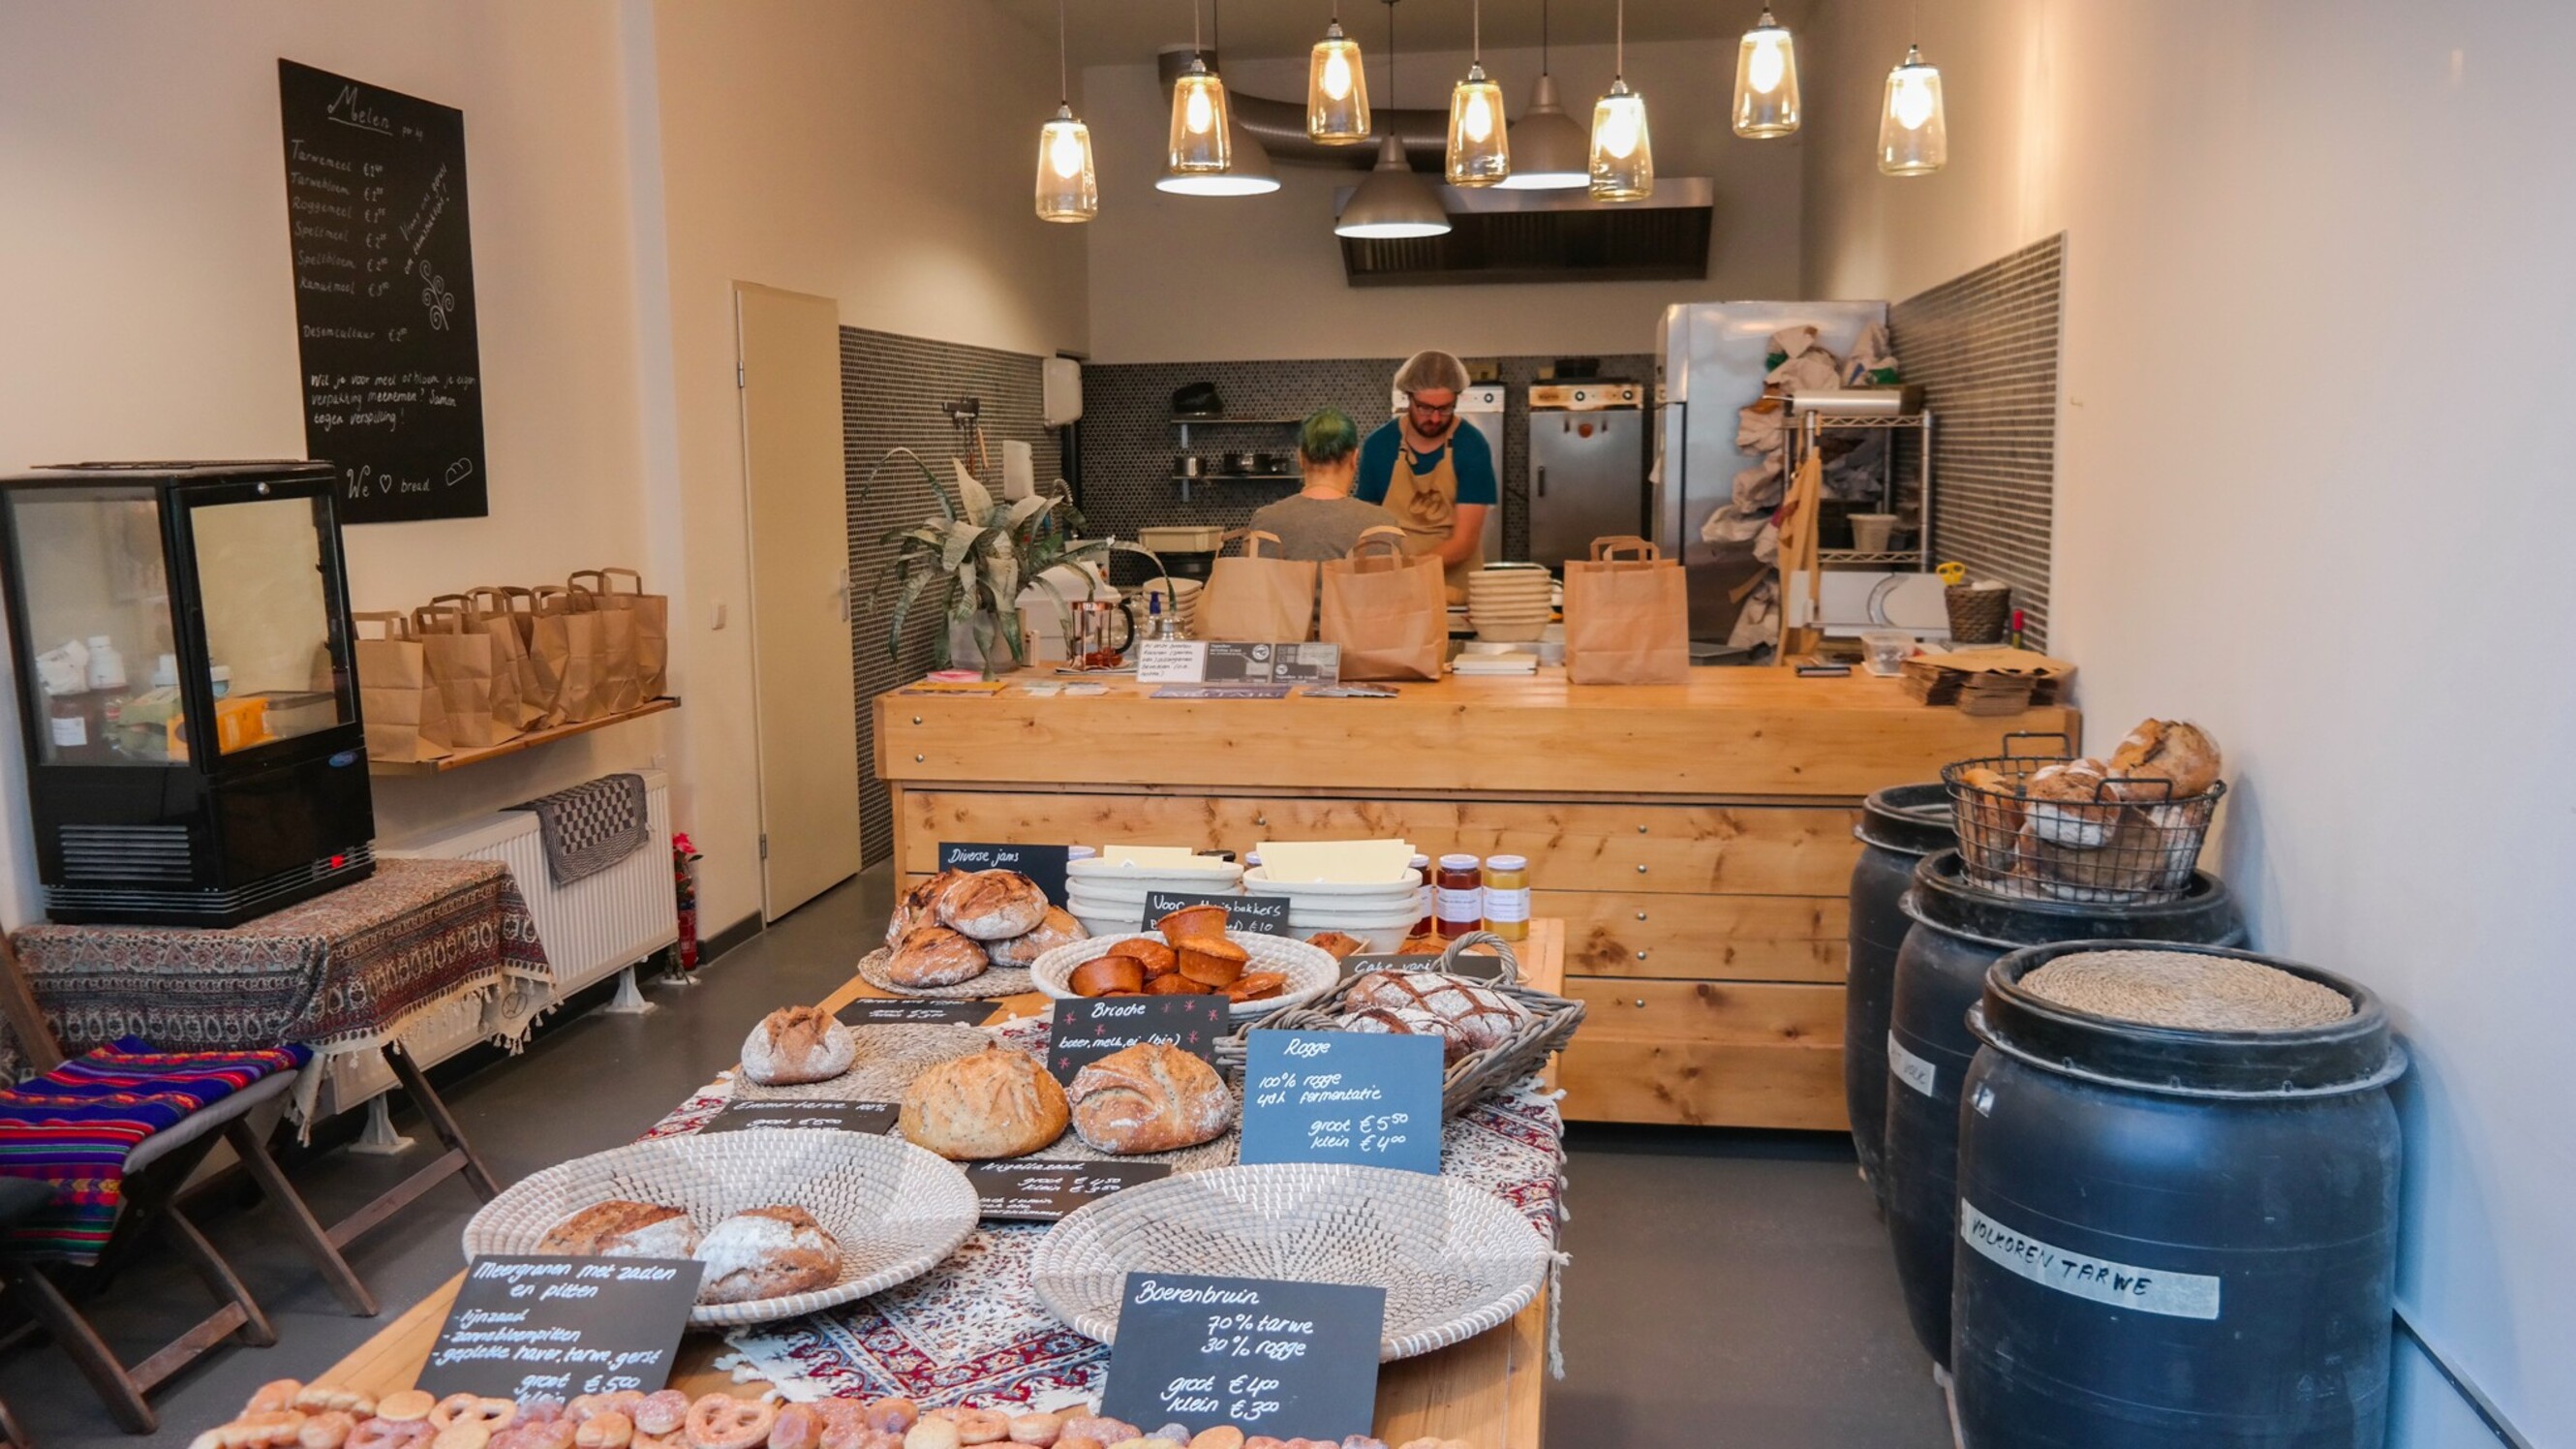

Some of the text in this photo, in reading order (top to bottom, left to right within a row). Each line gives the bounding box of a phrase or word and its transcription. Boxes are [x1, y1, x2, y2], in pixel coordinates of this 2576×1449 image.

[327, 84, 390, 129] Melen
[291, 139, 352, 172] Tarwemeel
[292, 196, 353, 219] Roggemeel
[294, 221, 350, 243] Speltmeel
[297, 249, 355, 269] Speltbloem
[302, 324, 376, 339] Desemcultuur
[311, 374, 329, 387] Wil
[334, 375, 347, 390] je
[351, 375, 371, 385] voor
[374, 375, 396, 386] meel
[311, 391, 362, 412] verpakking
[428, 389, 457, 407] Samen
[314, 412, 344, 433] tegen
[346, 464, 431, 500] We bread
[947, 848, 1020, 866] Diverse jams
[1153, 894, 1185, 910] Voor
[1354, 959, 1395, 974] Cake
[1090, 1002, 1147, 1019] Brioche
[1283, 1037, 1332, 1058] Rogge
[1258, 1071, 1342, 1089] 100% rogge
[1299, 1084, 1382, 1105] fermentatie
[1308, 1118, 1351, 1137] groot
[1310, 1134, 1350, 1150] klein
[1971, 1218, 2153, 1296] VOLKOREN TARWE
[473, 1260, 677, 1283] Meergranen met zaden
[509, 1282, 600, 1301] en pitten
[1134, 1279, 1260, 1306] Boerenbruin
[1208, 1312, 1314, 1336] 70% tarwe
[1200, 1336, 1307, 1361] 30% rogge
[513, 1372, 571, 1397] groot
[1160, 1374, 1215, 1402] groot
[1166, 1395, 1220, 1413] klein
